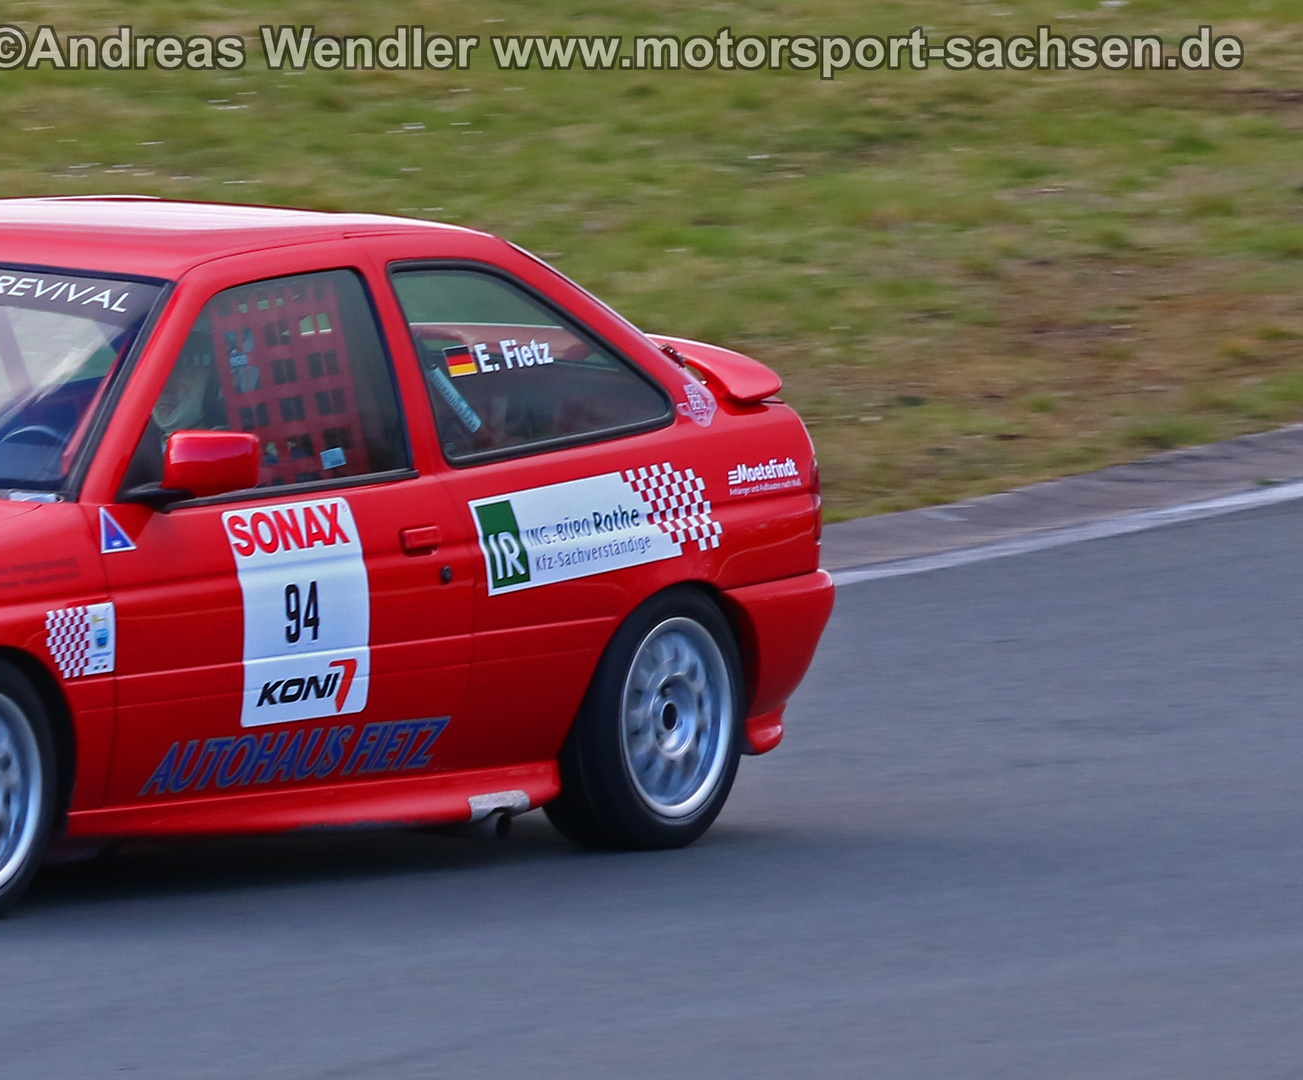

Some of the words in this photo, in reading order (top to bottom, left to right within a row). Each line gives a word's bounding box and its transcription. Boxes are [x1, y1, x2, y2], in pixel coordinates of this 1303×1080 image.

[474, 343, 500, 373] E.
[499, 338, 554, 369] Fietz
[227, 502, 351, 557] SONAX
[525, 517, 592, 548] ING.-BÜRO
[592, 504, 641, 535] Rothe
[488, 531, 526, 580] IR
[534, 535, 652, 572] Kfz-Sachverständige
[284, 580, 320, 644] 94
[256, 670, 341, 708] KONI
[137, 724, 355, 796] AUTOHAUS
[344, 716, 451, 777] FIETZ
